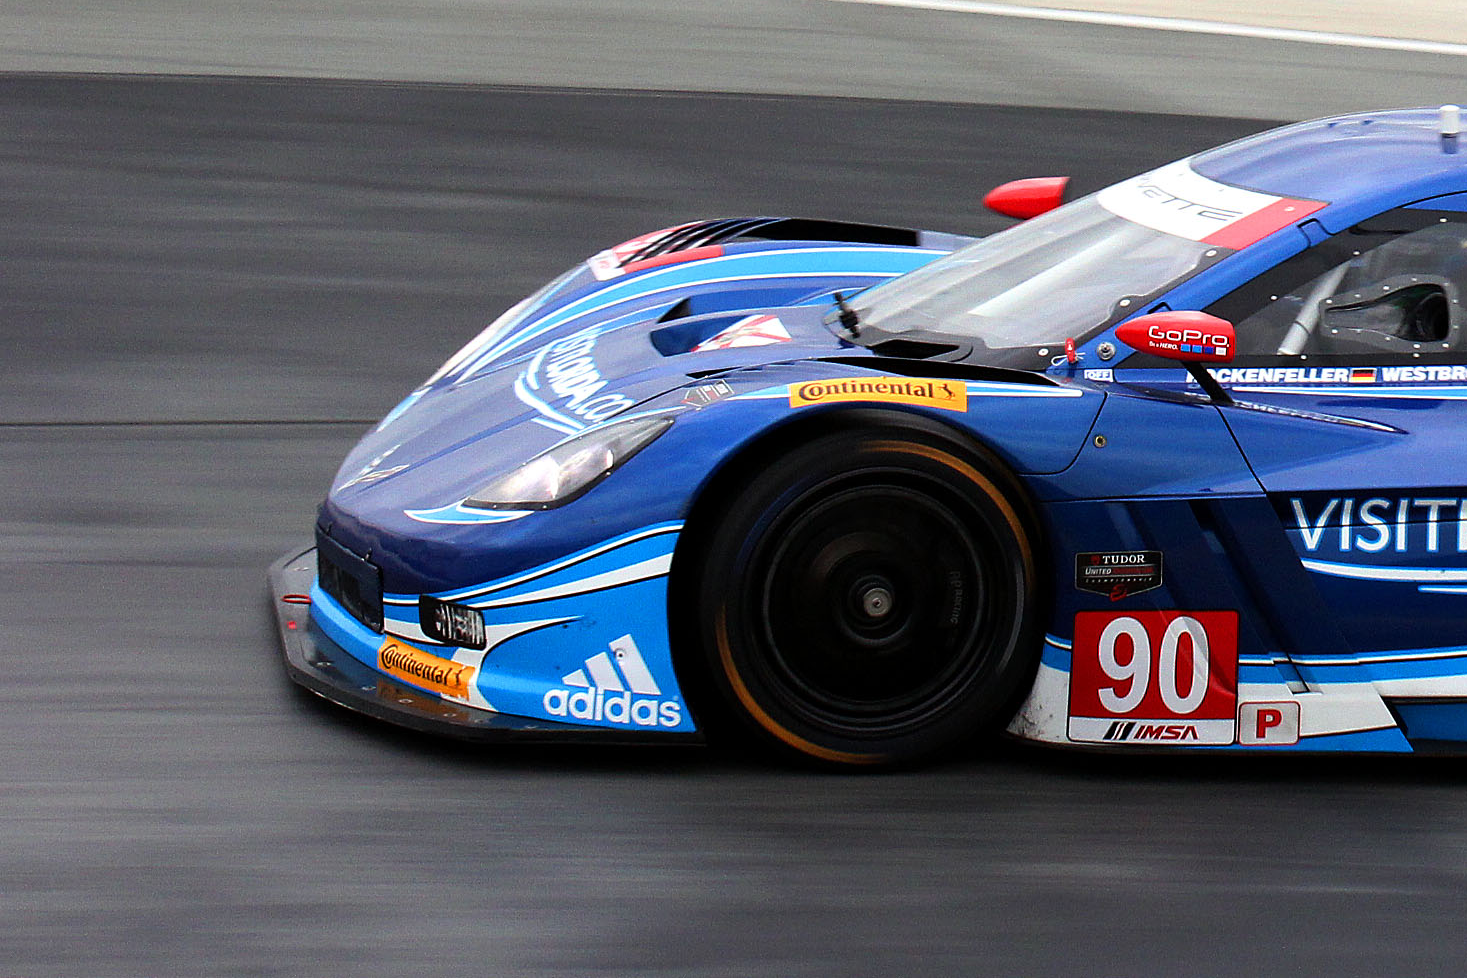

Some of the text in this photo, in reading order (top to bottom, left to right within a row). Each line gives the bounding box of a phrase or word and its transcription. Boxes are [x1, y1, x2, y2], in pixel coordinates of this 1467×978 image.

[799, 380, 934, 401] Continental
[1103, 555, 1145, 564] TUDOR
[381, 644, 452, 686] Continental
[1098, 616, 1209, 714] 90
[543, 687, 681, 728] adidas
[1134, 725, 1198, 740] IMSA
[1256, 709, 1282, 739] P
